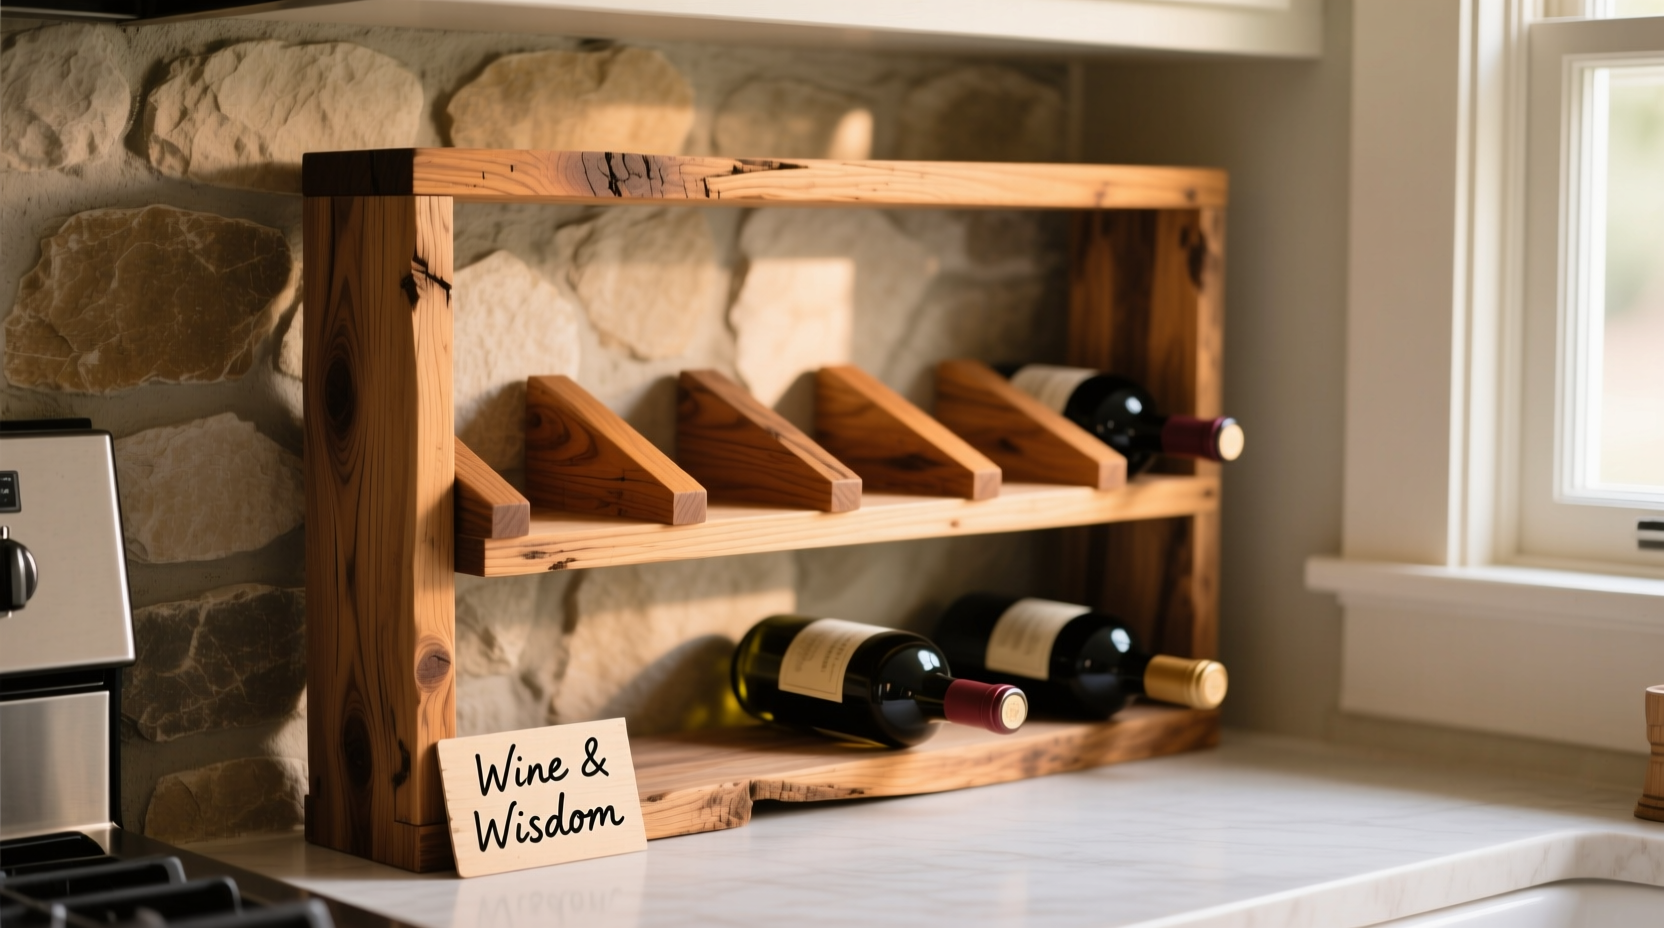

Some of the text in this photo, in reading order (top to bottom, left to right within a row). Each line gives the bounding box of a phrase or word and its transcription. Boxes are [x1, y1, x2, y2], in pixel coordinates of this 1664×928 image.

[475, 737, 610, 796] Wine &
[474, 791, 625, 853] Wisdom
